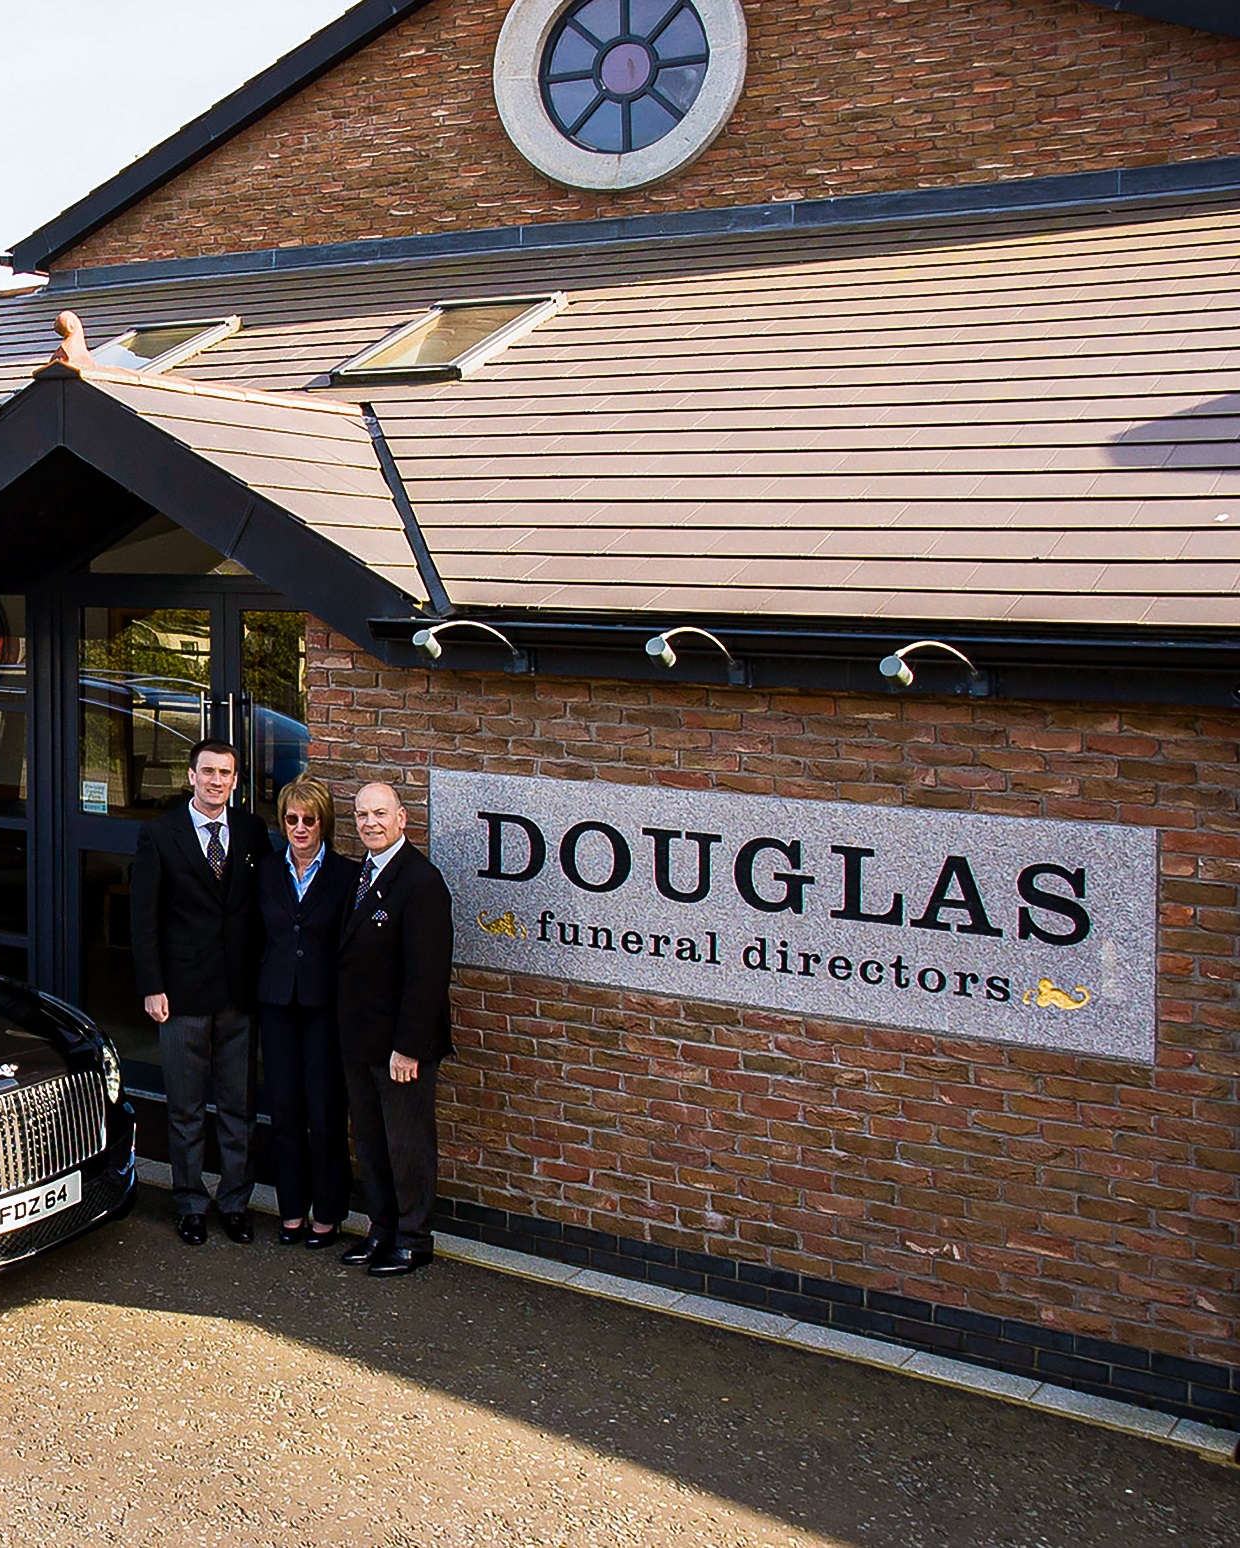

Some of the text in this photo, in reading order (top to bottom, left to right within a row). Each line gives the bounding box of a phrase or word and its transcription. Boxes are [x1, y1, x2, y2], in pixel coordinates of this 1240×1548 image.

[476, 811, 1092, 947] DOUGLAS
[537, 911, 1011, 1002] funeral directors
[0, 1183, 68, 1225] FDZ 64
